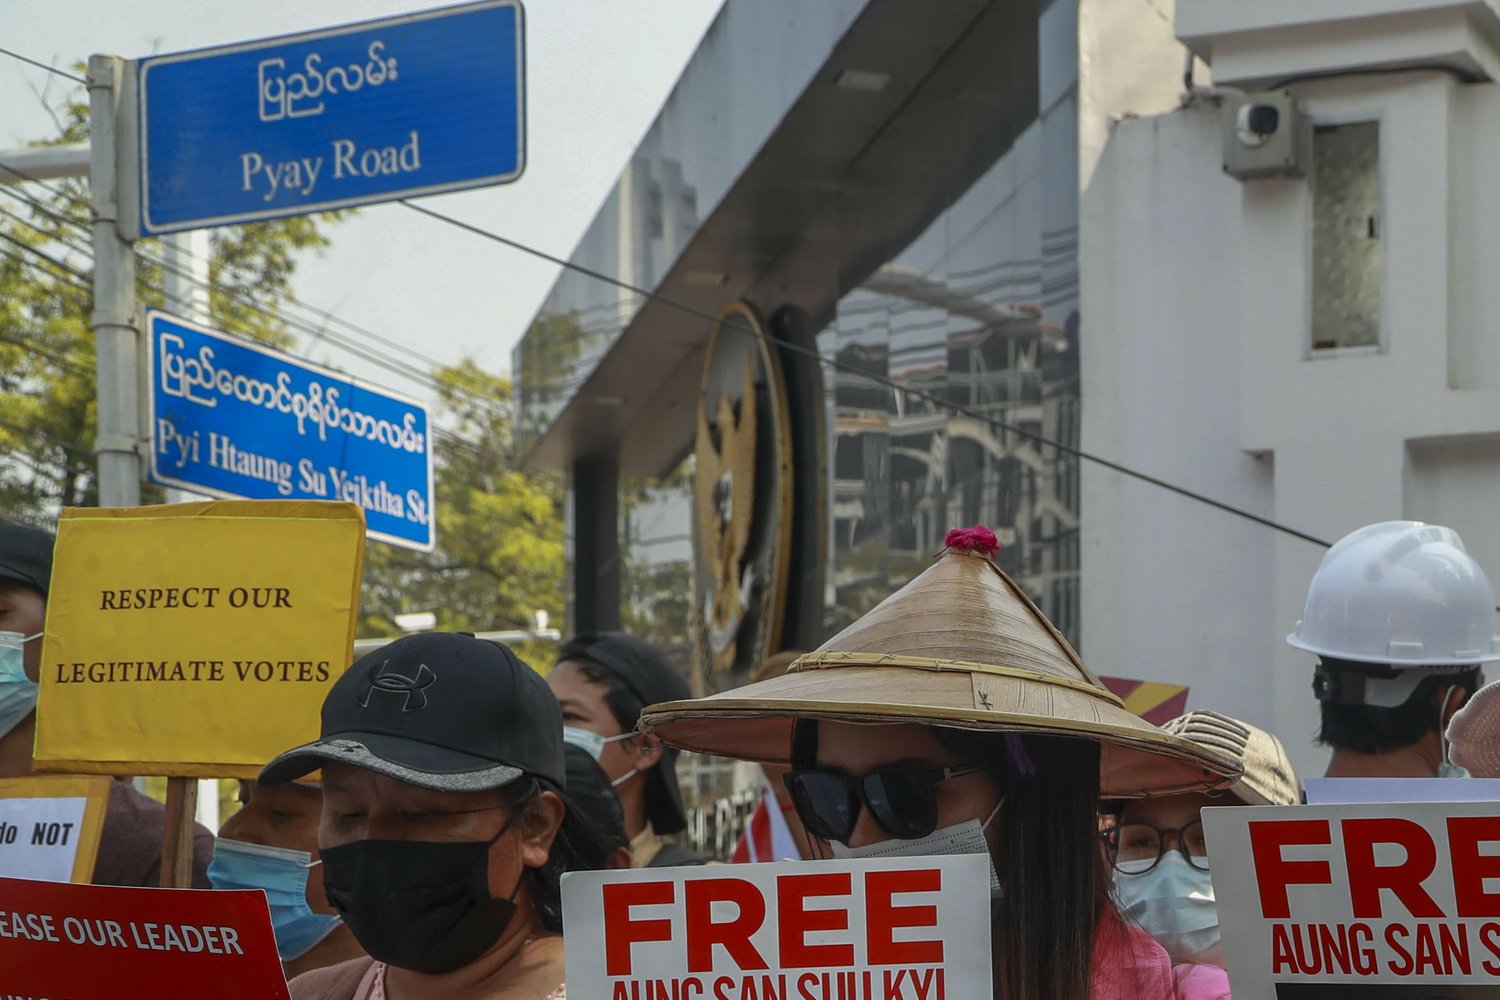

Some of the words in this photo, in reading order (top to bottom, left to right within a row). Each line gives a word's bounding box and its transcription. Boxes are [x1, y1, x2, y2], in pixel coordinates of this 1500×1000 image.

[259, 40, 398, 122] ပြည်လမ်း
[240, 152, 323, 202] Pyay
[332, 130, 421, 179] Road
[157, 418, 200, 468] Pyi
[208, 432, 293, 495] Htaung
[299, 458, 327, 497] Su
[328, 465, 404, 518] Yeiktha
[99, 586, 219, 610] RESPECT
[228, 587, 292, 608] OUR
[55, 660, 225, 684] LEGITIMATE
[232, 660, 330, 683] VOTES
[31, 822, 74, 846] NOT
[63, 917, 128, 948] OUR
[129, 921, 244, 955] LEADER
[602, 868, 944, 976] FREE
[1271, 922, 1377, 976] AUNG
[1386, 922, 1473, 976] SAN
